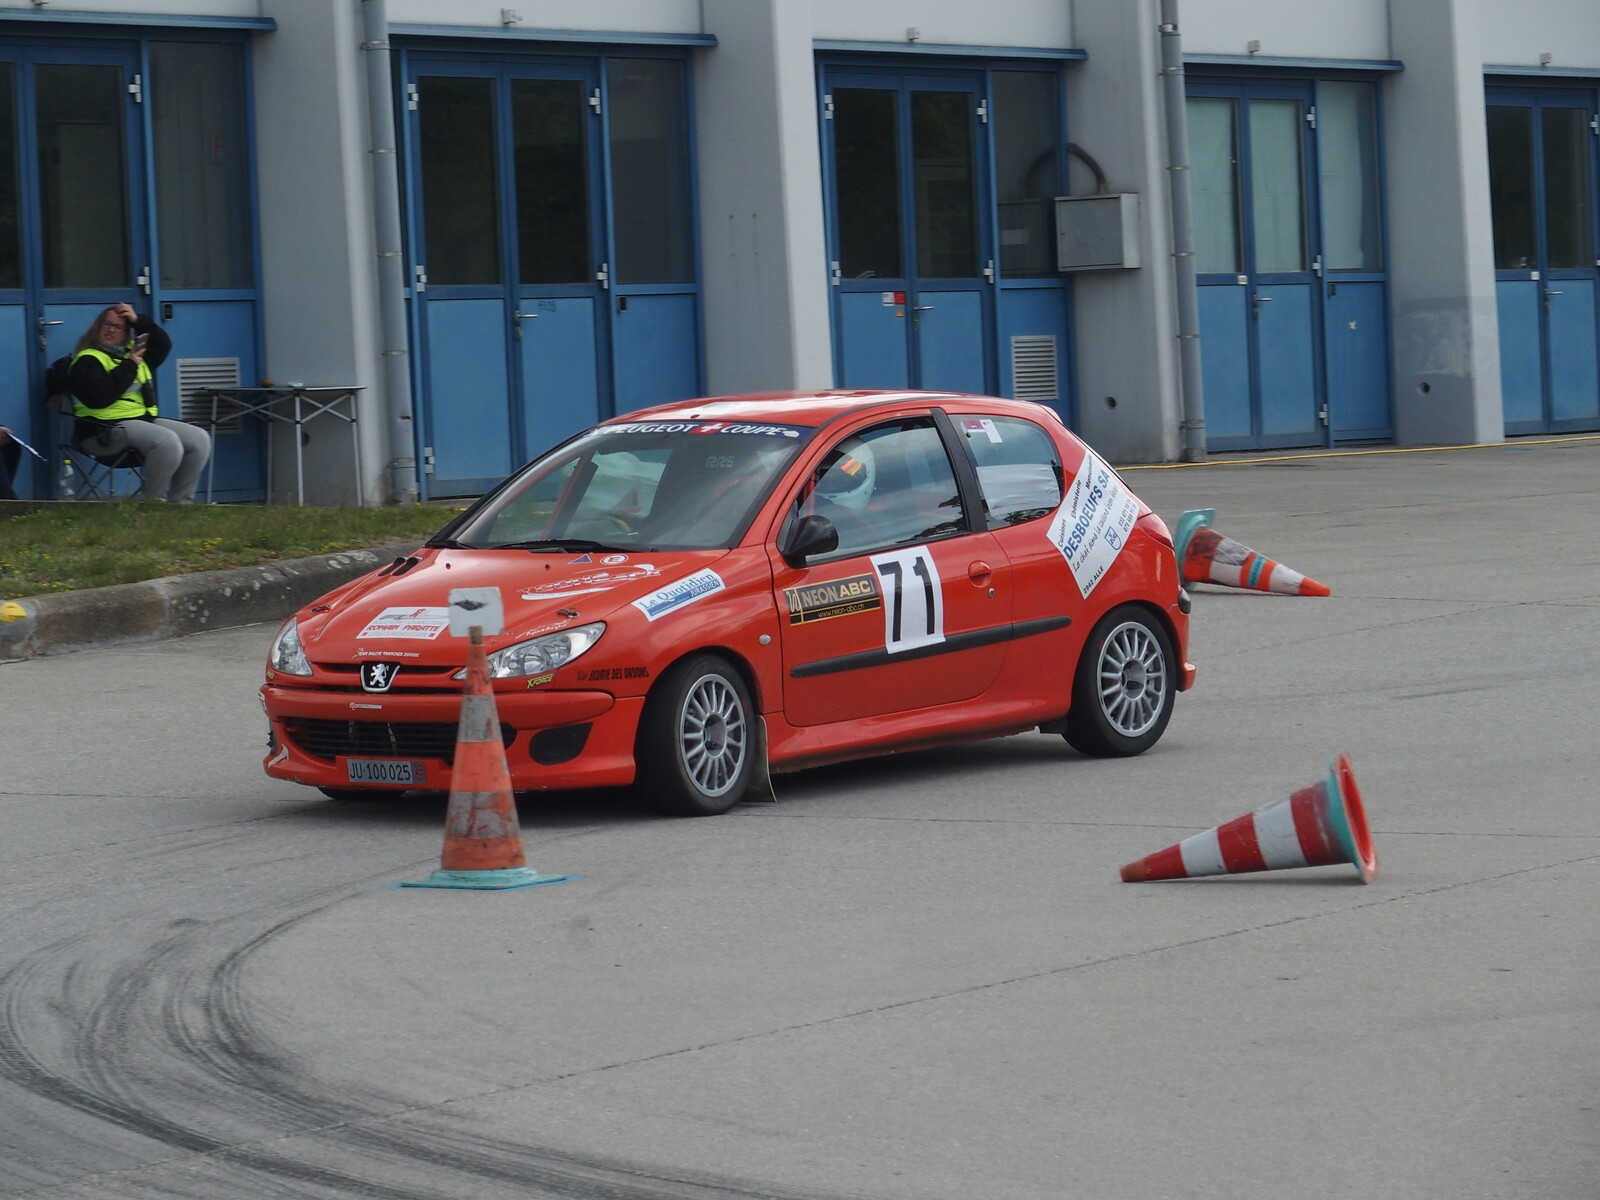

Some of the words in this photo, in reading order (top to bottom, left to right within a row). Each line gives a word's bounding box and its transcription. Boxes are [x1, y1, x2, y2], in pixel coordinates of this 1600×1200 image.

[606, 423, 700, 434] PEUGEOT
[720, 424, 787, 437] COUPE
[705, 455, 736, 469] RRS
[1062, 485, 1104, 561] DESBOEUFS
[1098, 469, 1110, 488] SA
[1058, 519, 1067, 548] Cuisines
[1093, 566, 1104, 581] ALLE
[639, 596, 657, 611] Le
[656, 572, 715, 603] Quotidien
[687, 579, 721, 598] JURASSIEN
[802, 586, 839, 607] NEON
[839, 580, 872, 597] ABC
[877, 556, 936, 643] 71
[818, 603, 865, 618] www.neon-abc.ch
